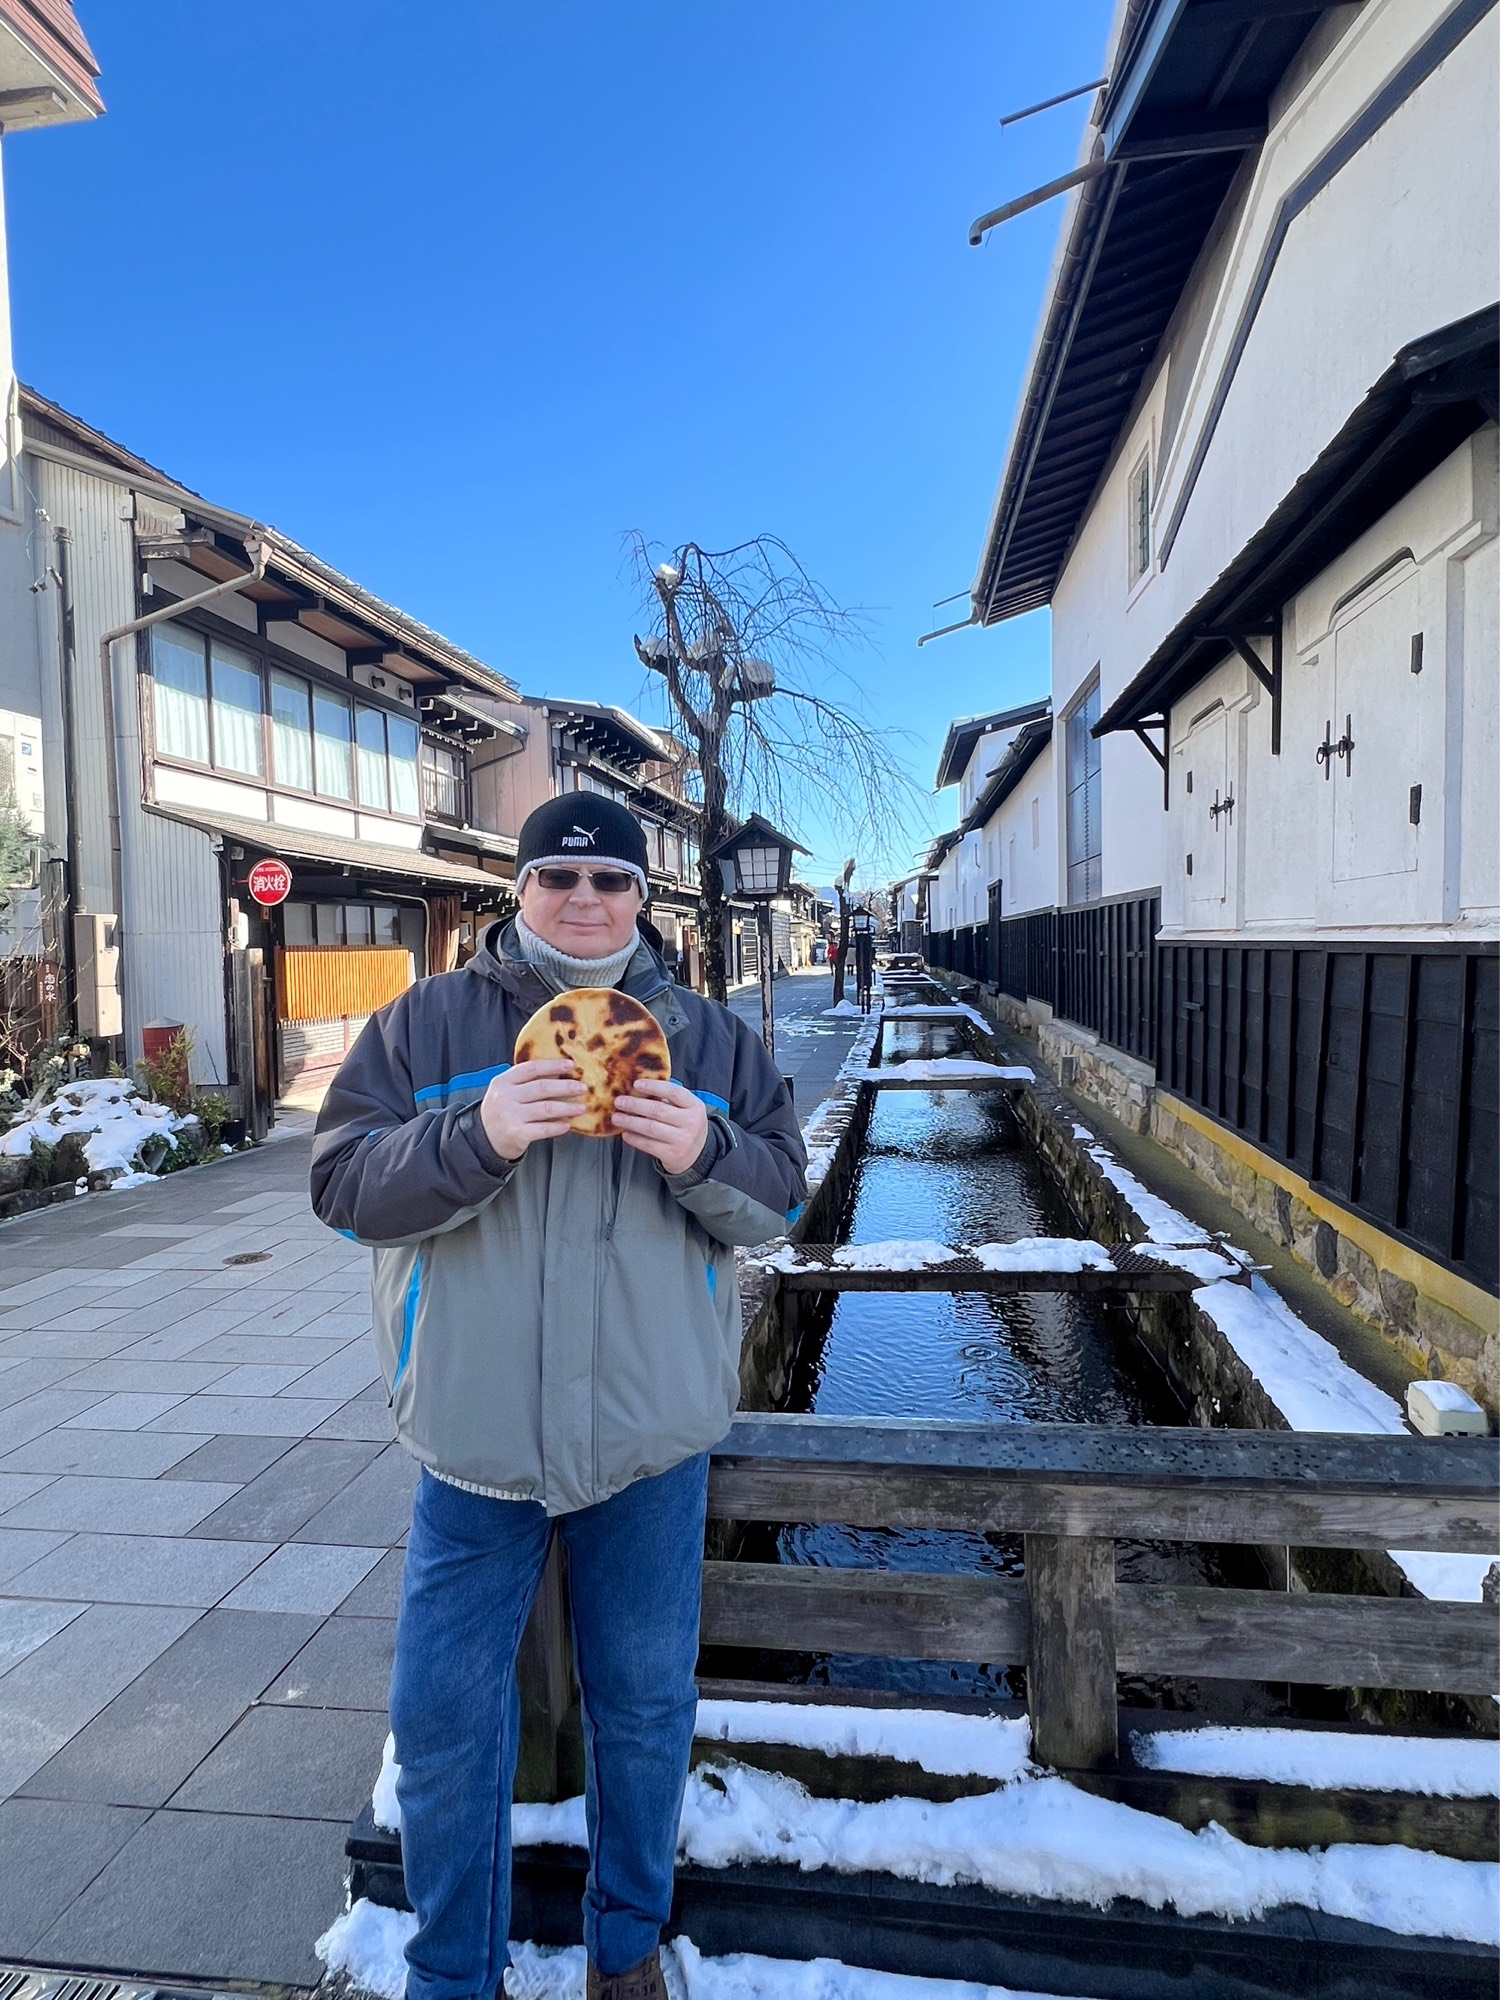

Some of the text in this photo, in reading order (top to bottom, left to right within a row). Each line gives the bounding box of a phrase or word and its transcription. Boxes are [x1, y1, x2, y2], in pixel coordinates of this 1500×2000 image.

[562, 836, 589, 847] PUMA
[253, 874, 286, 892] 消火栓
